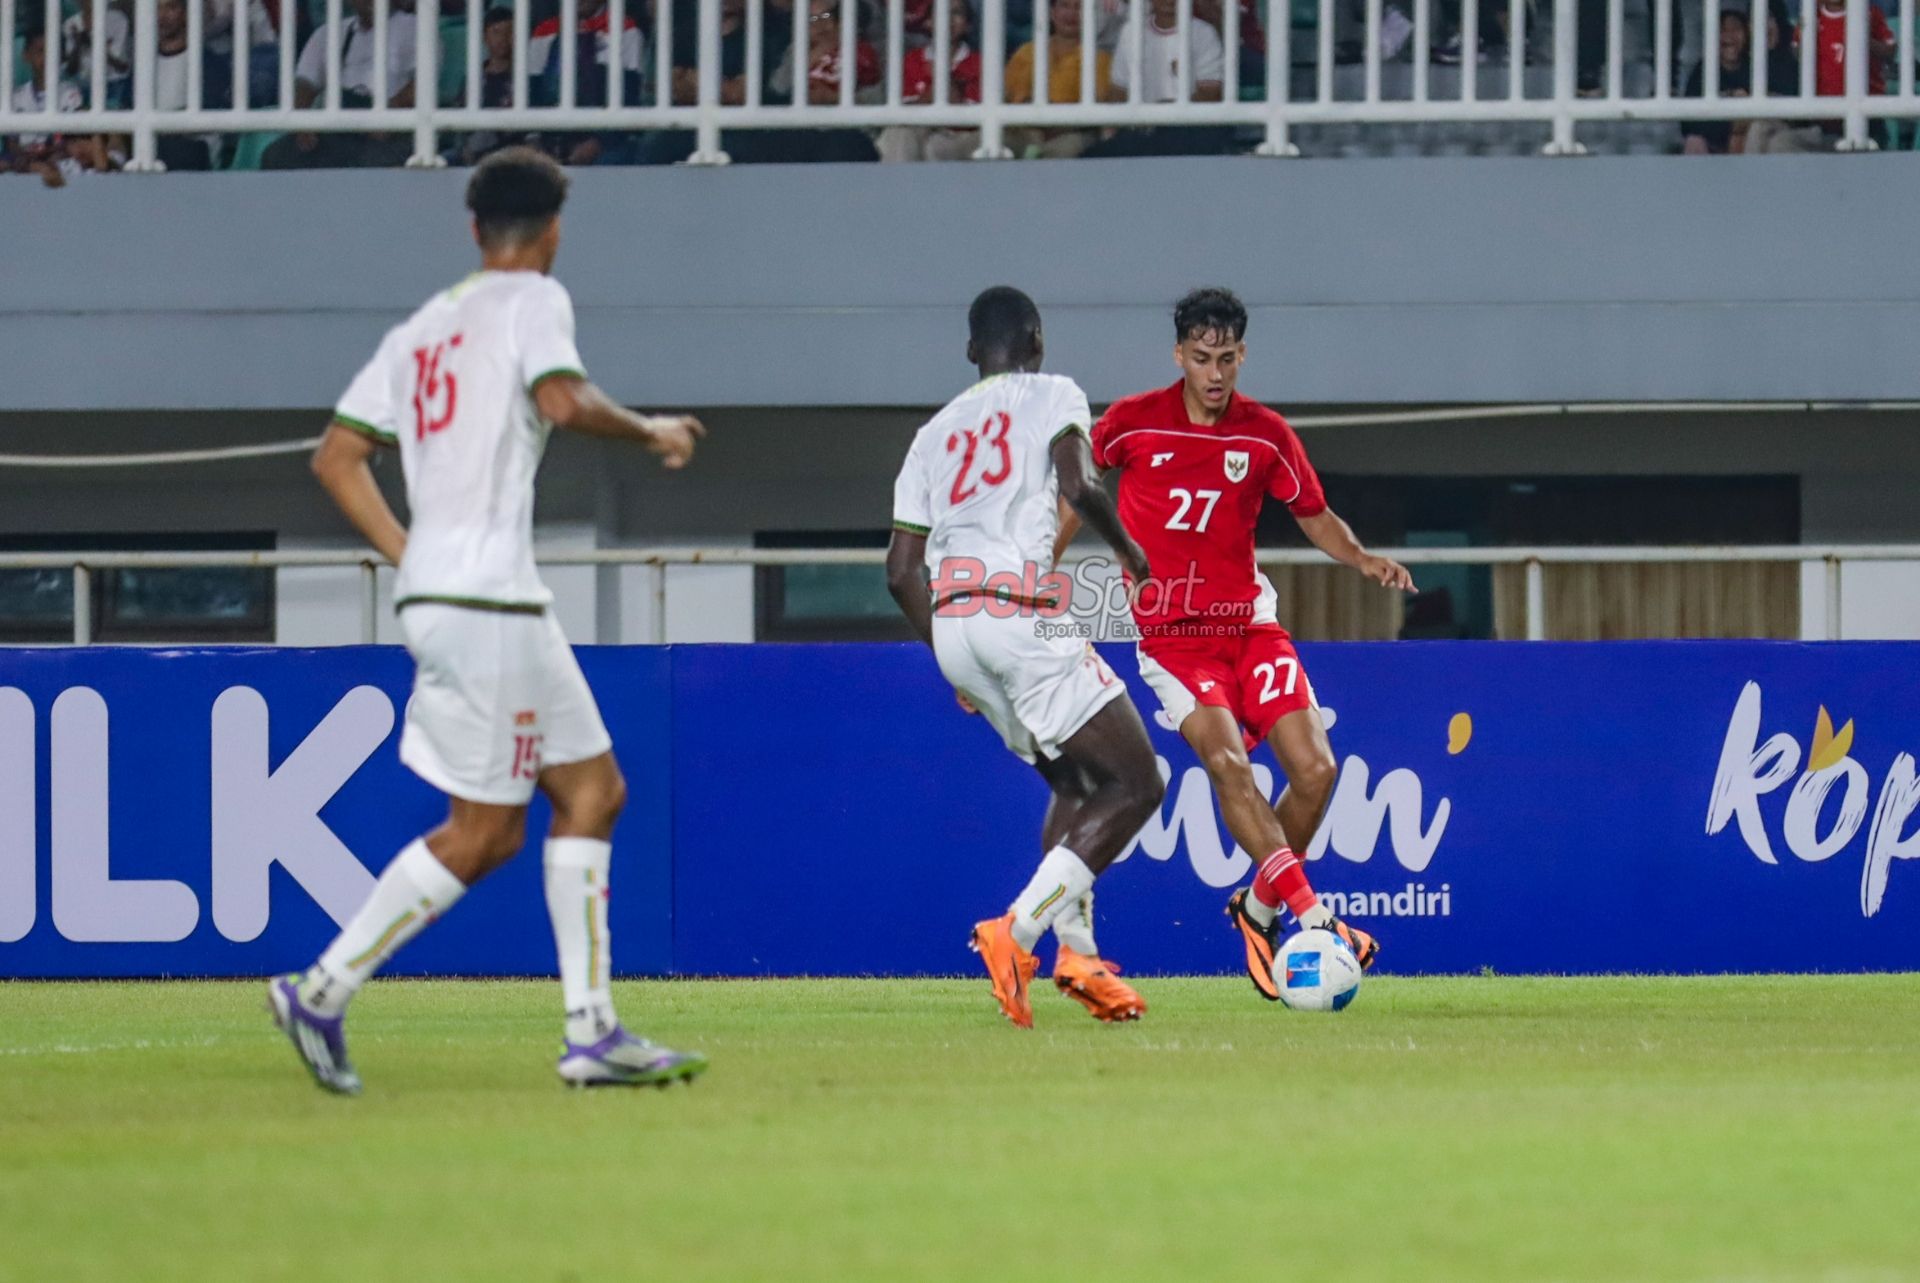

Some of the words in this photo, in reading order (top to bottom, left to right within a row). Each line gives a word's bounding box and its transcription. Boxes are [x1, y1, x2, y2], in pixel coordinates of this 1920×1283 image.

[946, 410, 1012, 506] 23
[1164, 487, 1222, 533] 27
[1253, 656, 1298, 705] 27
